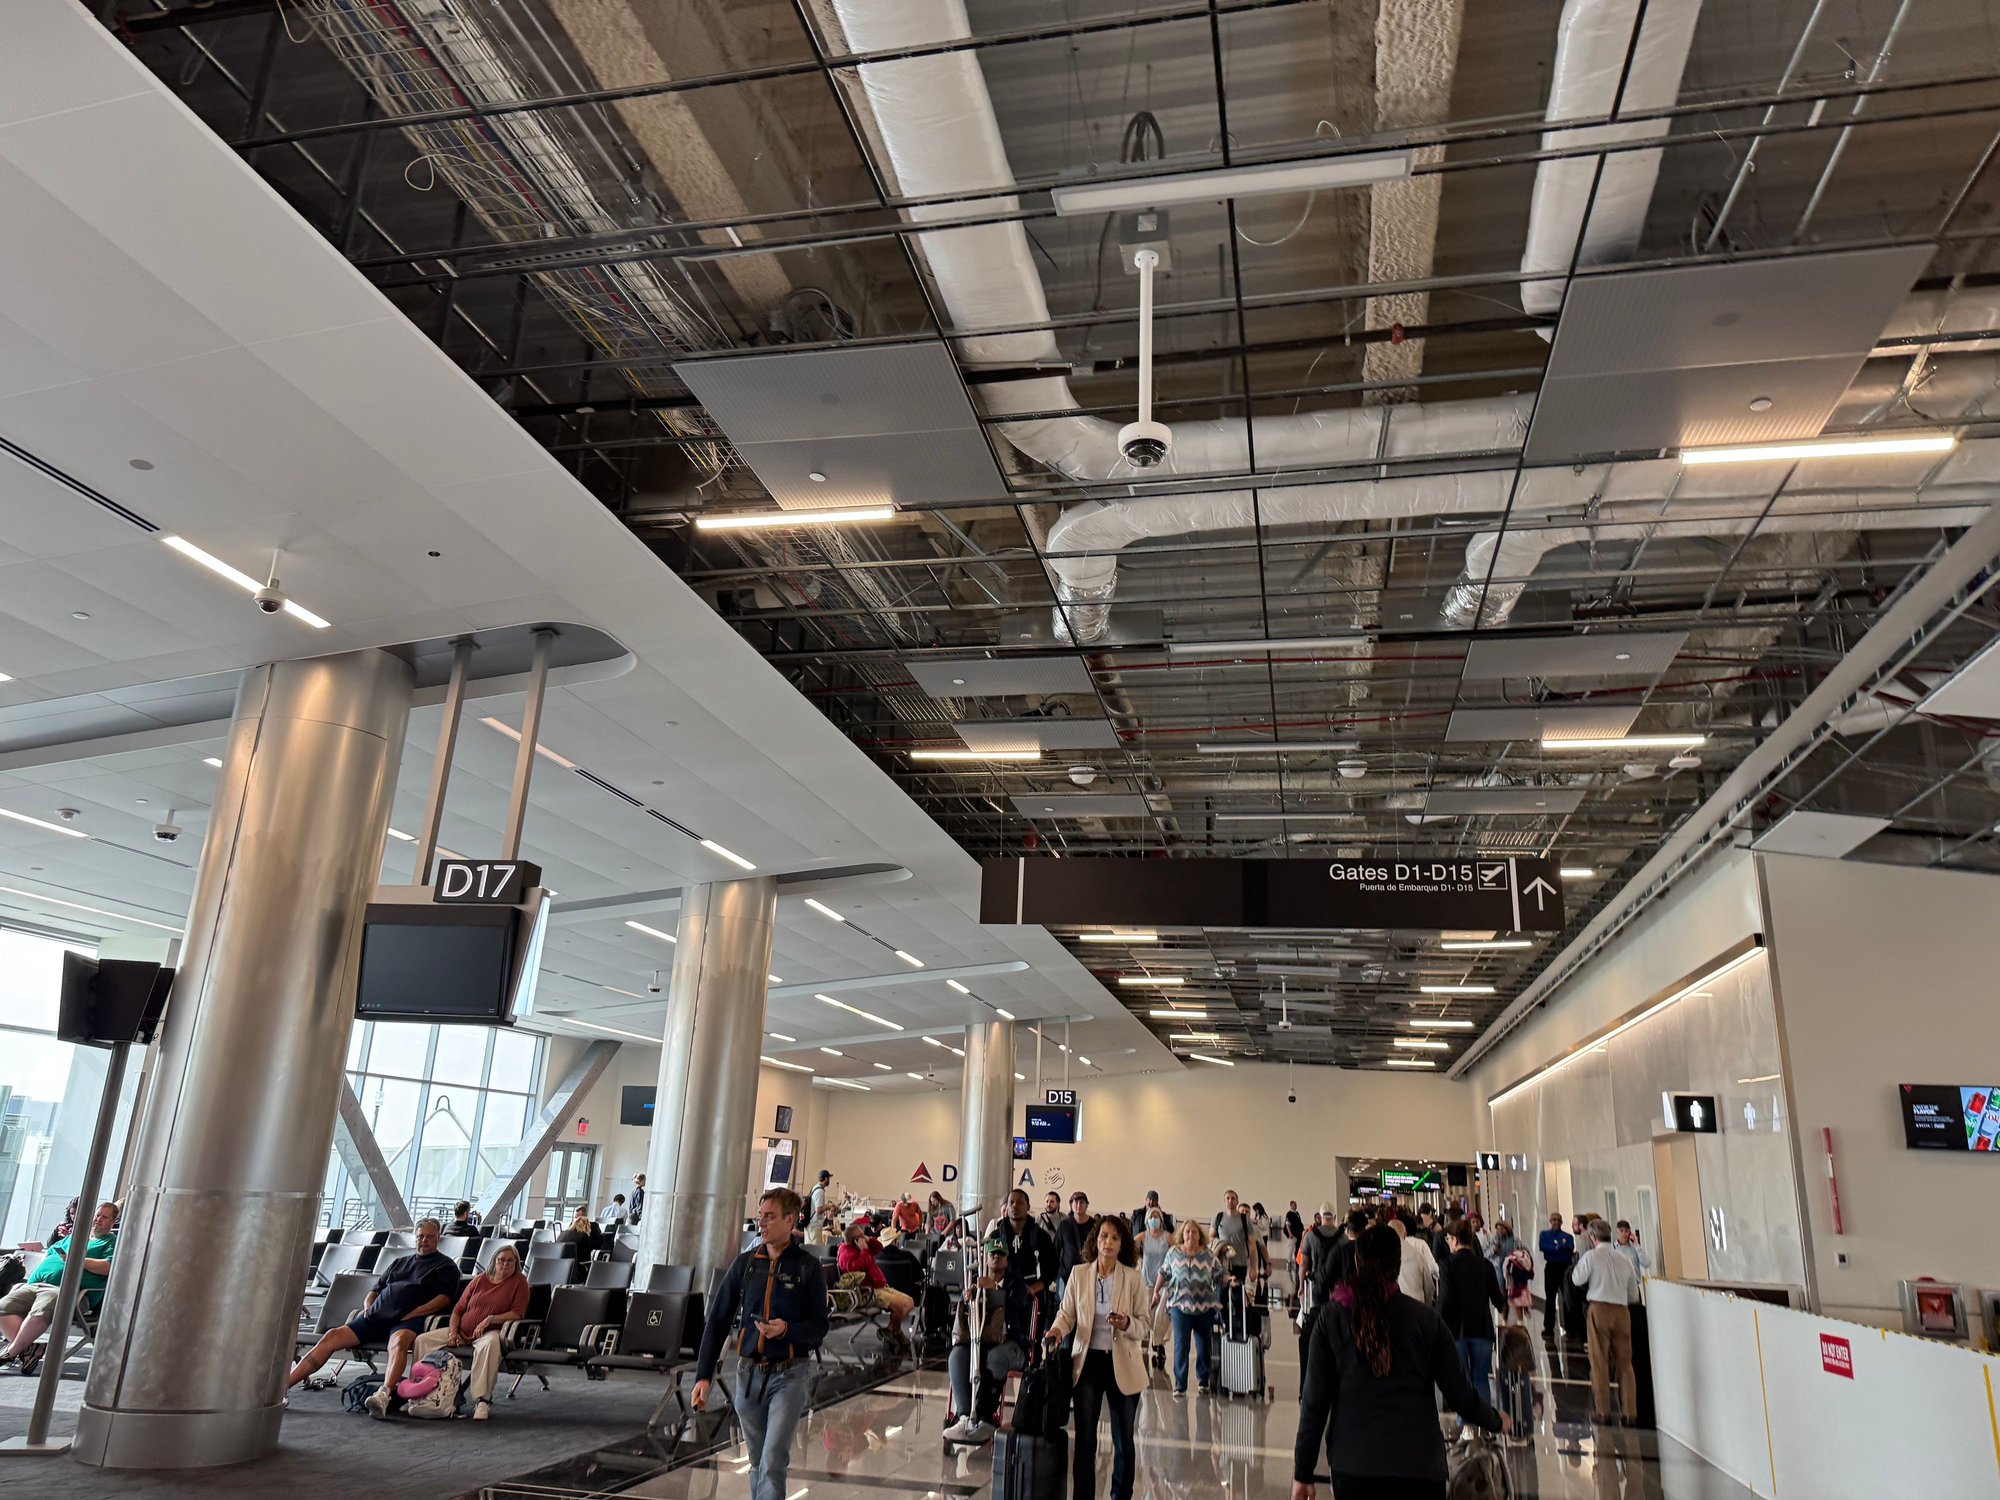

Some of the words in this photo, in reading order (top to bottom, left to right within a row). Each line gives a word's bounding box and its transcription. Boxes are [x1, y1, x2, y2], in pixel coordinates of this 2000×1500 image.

[1329, 863, 1389, 881] Gates
[1395, 863, 1473, 881] D1-D15
[442, 864, 515, 898] D17
[1360, 883, 1385, 891] Puerta
[1387, 883, 1397, 892] de
[1399, 884, 1439, 893] Embarque
[1457, 884, 1473, 892] D15
[1048, 1090, 1072, 1104] D15
[993, 1240, 1003, 1249] LA
[1836, 1345, 1849, 1361] ENTER
